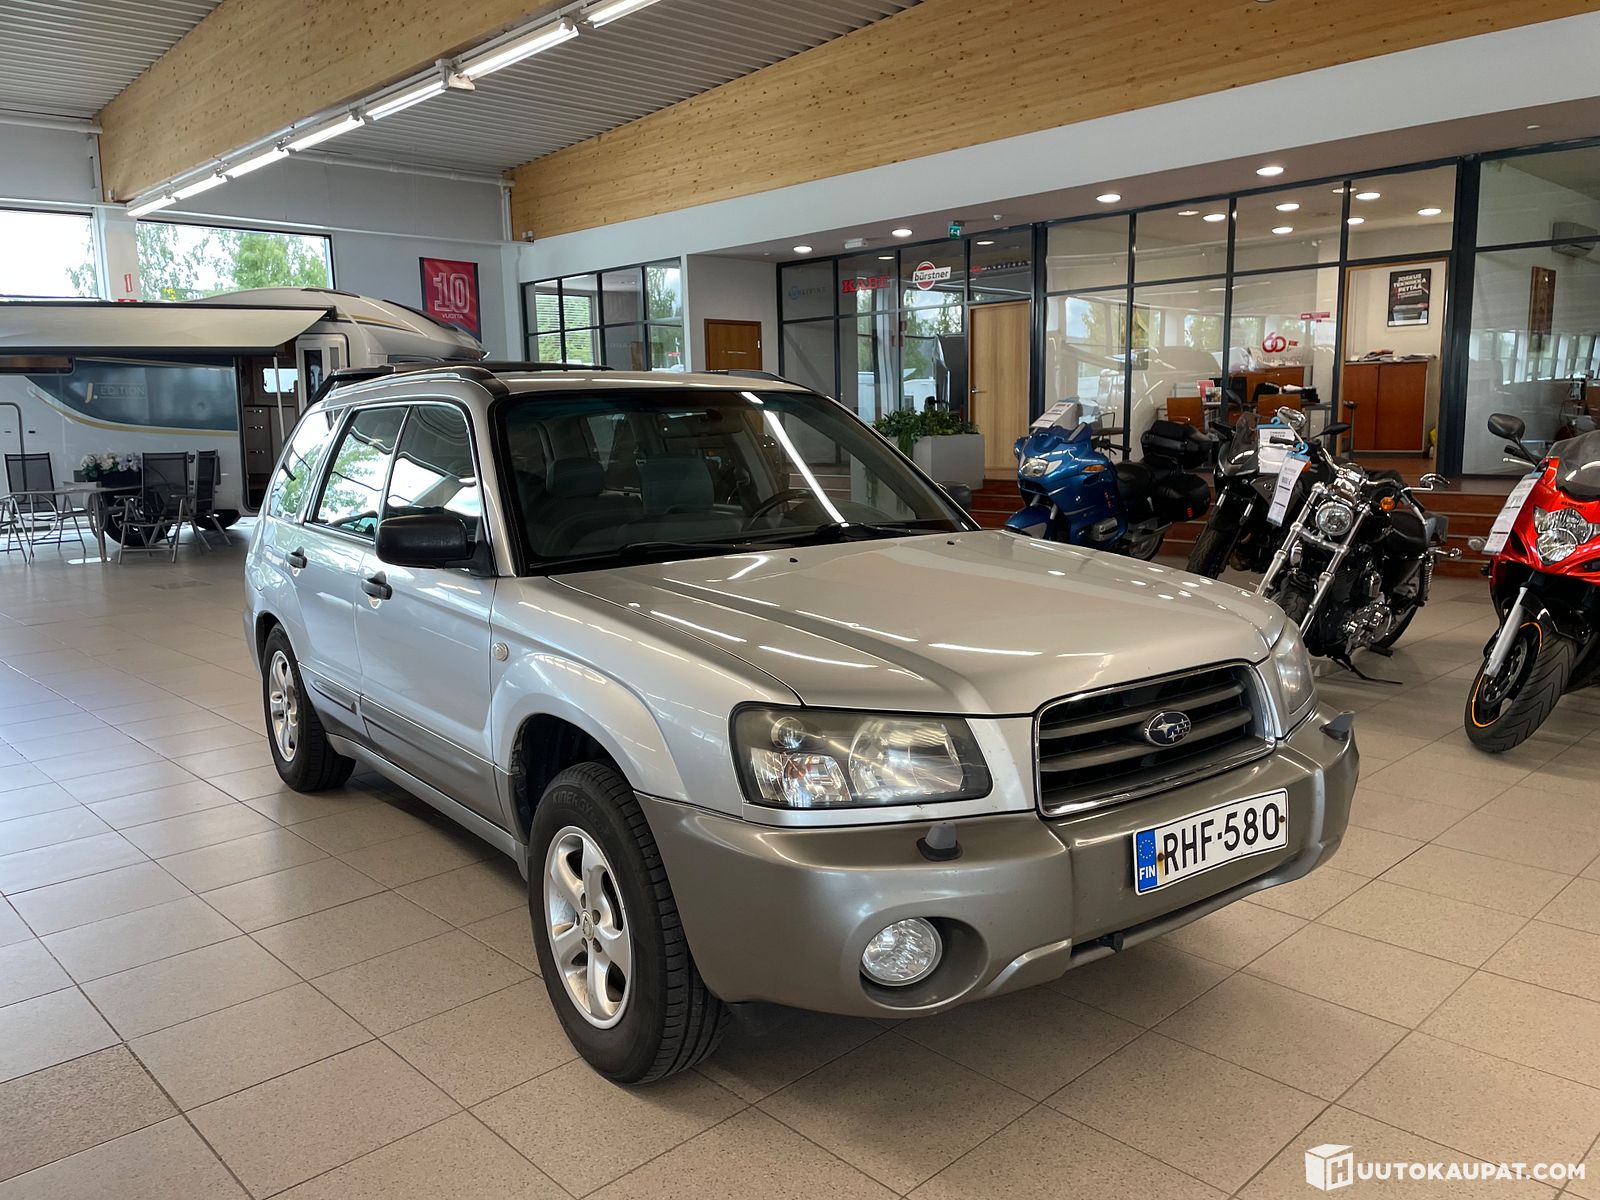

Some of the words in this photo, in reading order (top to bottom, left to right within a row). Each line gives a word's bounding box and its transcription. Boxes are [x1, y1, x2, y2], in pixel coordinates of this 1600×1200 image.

[432, 272, 470, 313] 10
[914, 270, 949, 281] bürstner
[1139, 864, 1156, 881] FIN
[1163, 802, 1280, 876] RHF-580
